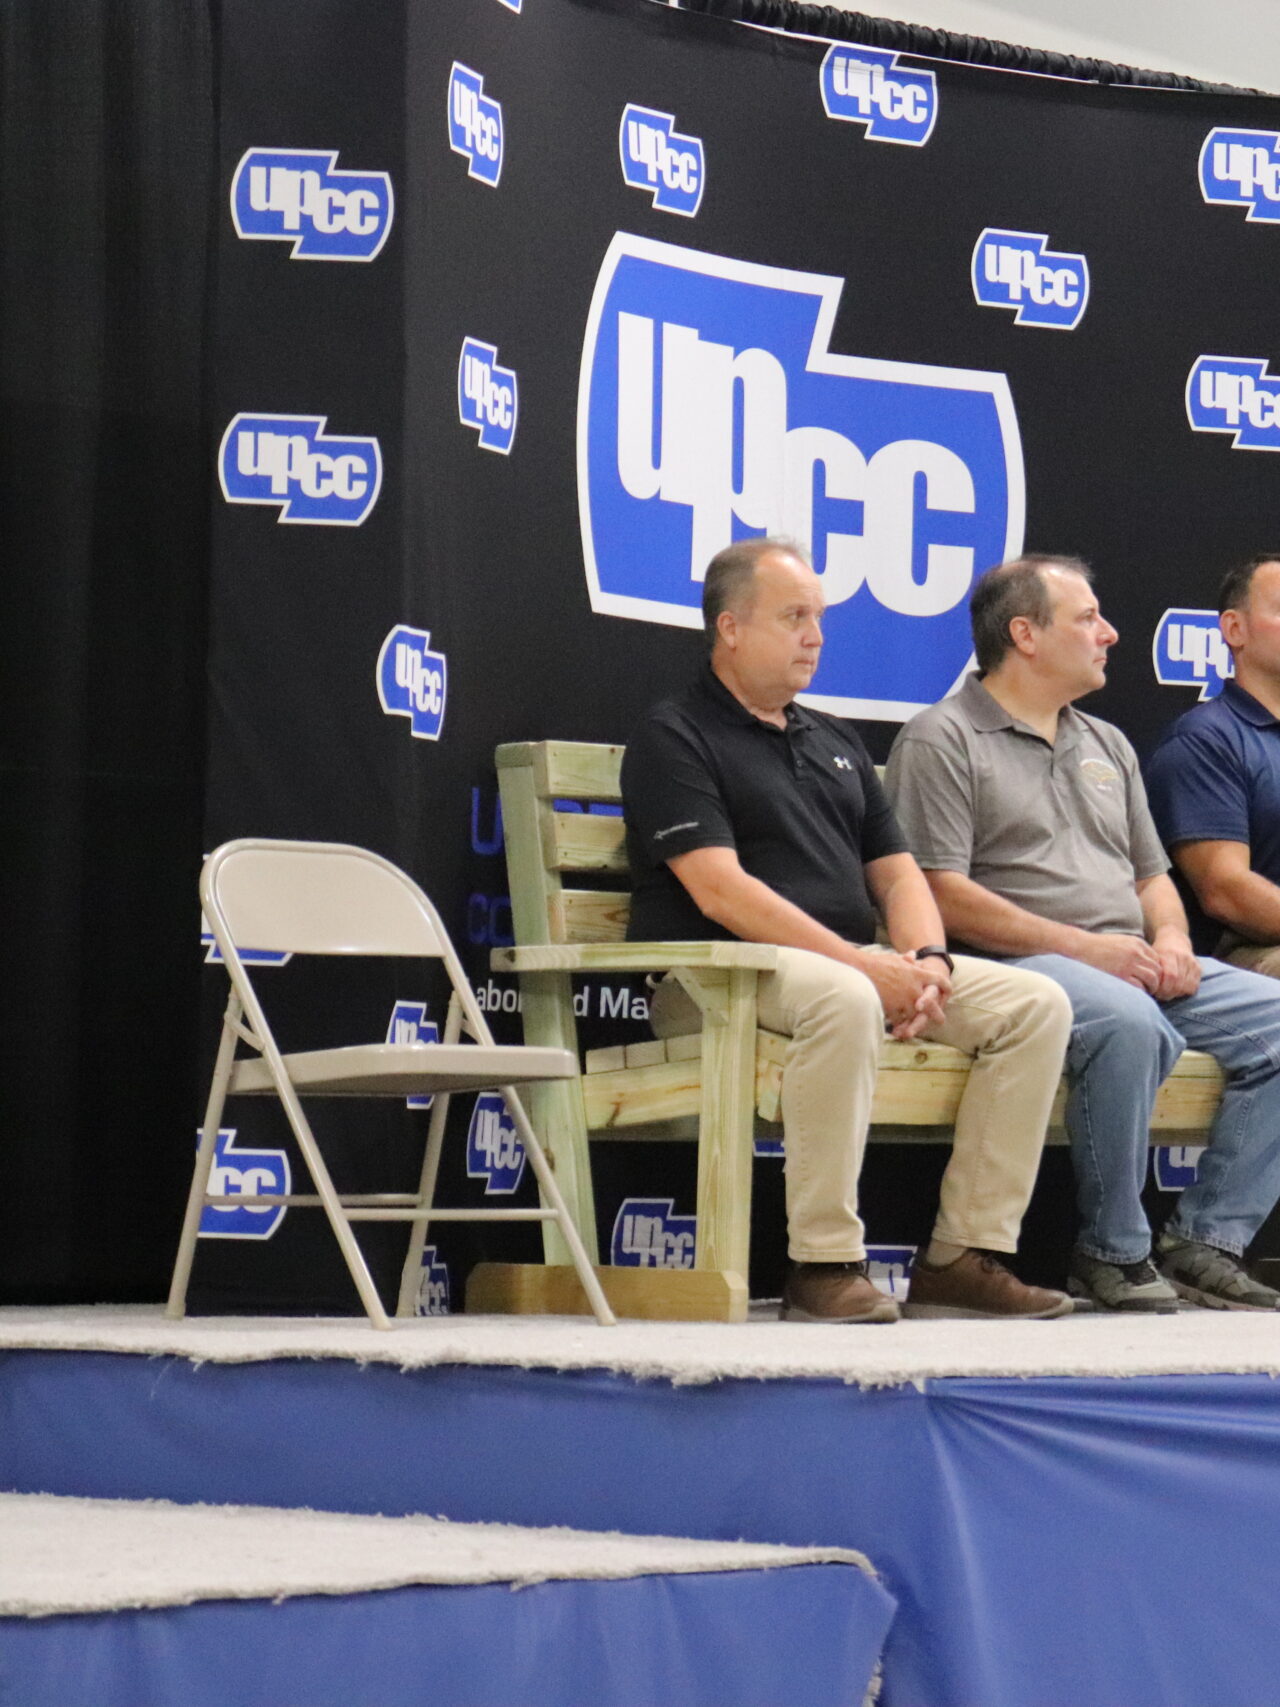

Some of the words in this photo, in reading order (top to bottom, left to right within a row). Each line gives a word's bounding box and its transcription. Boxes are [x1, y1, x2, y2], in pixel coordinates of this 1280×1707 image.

[453, 78, 499, 162] upcc
[833, 53, 928, 124] upcc
[628, 120, 698, 191] upcc
[249, 166, 380, 236] upcc
[984, 244, 1079, 307] upcc
[464, 354, 512, 430] upcc
[236, 431, 368, 499] upcc
[395, 642, 441, 715] upcc
